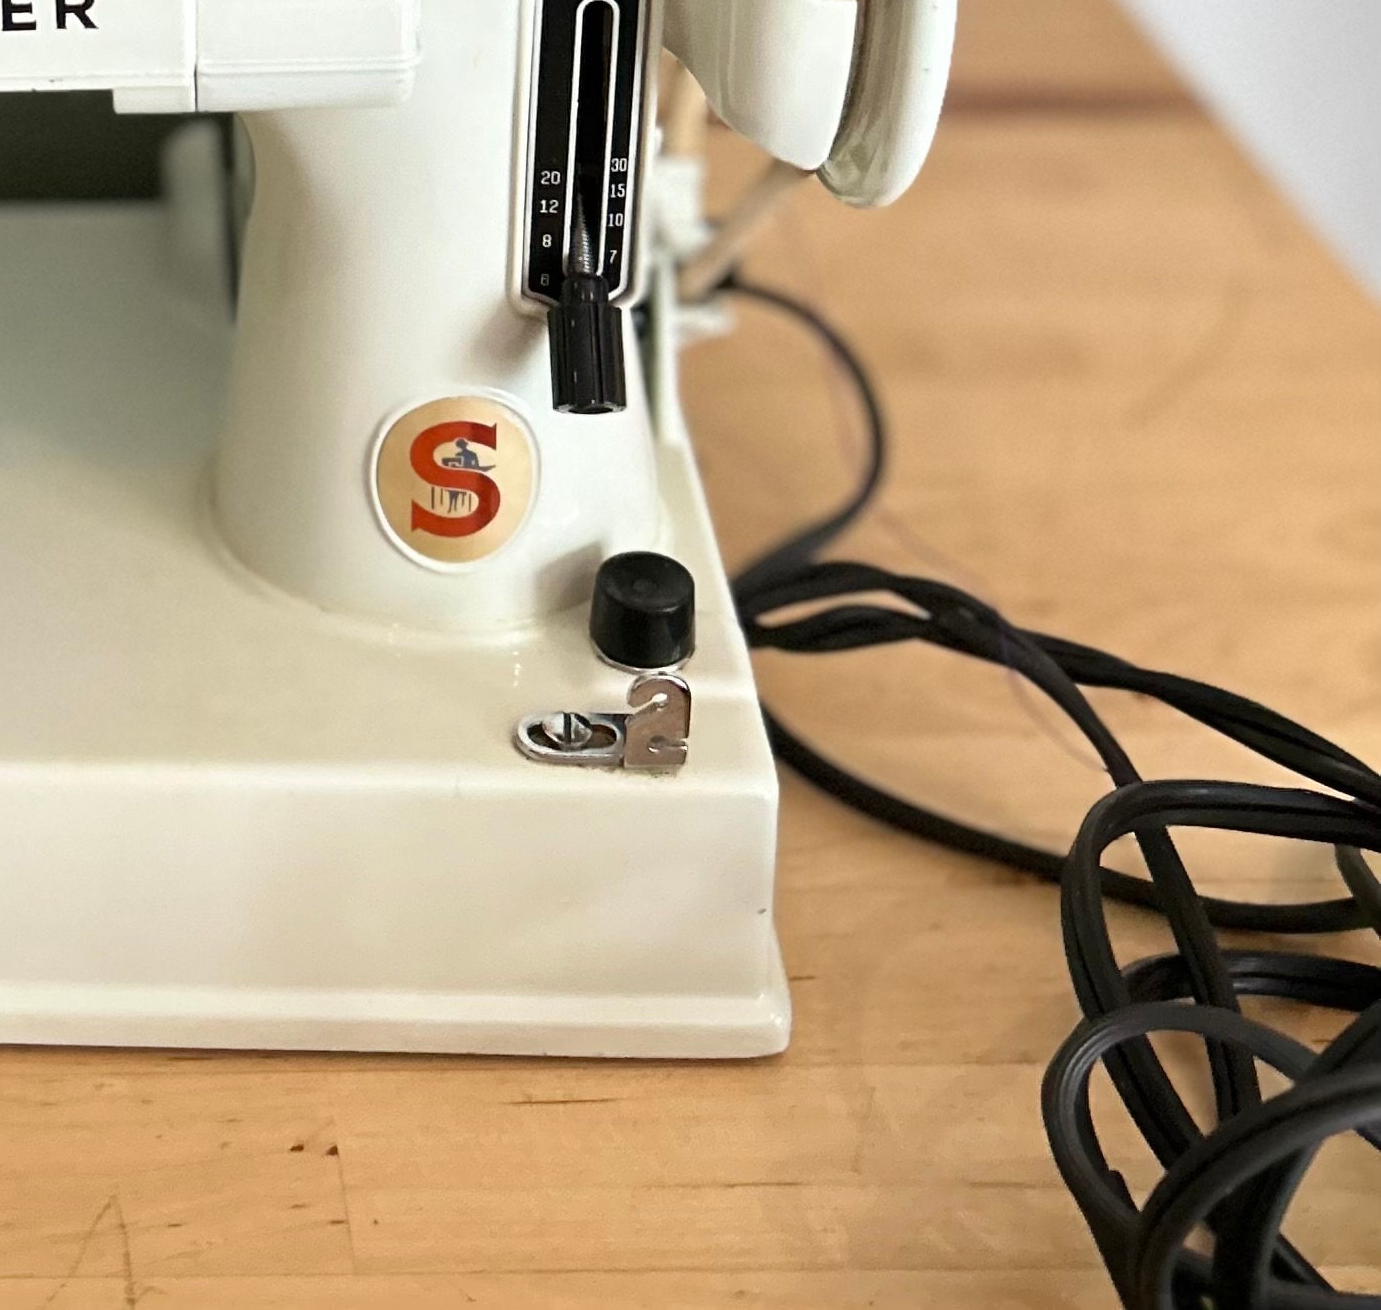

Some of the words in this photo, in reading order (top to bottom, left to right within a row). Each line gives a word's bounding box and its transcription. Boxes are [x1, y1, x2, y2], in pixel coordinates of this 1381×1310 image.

[610, 158, 628, 172] 30
[540, 170, 561, 185] 20
[610, 183, 626, 198] 15
[539, 199, 559, 213] 12
[608, 213, 624, 227] 10
[542, 234, 552, 248] 8
[609, 250, 617, 264] 7
[409, 420, 501, 538] S
